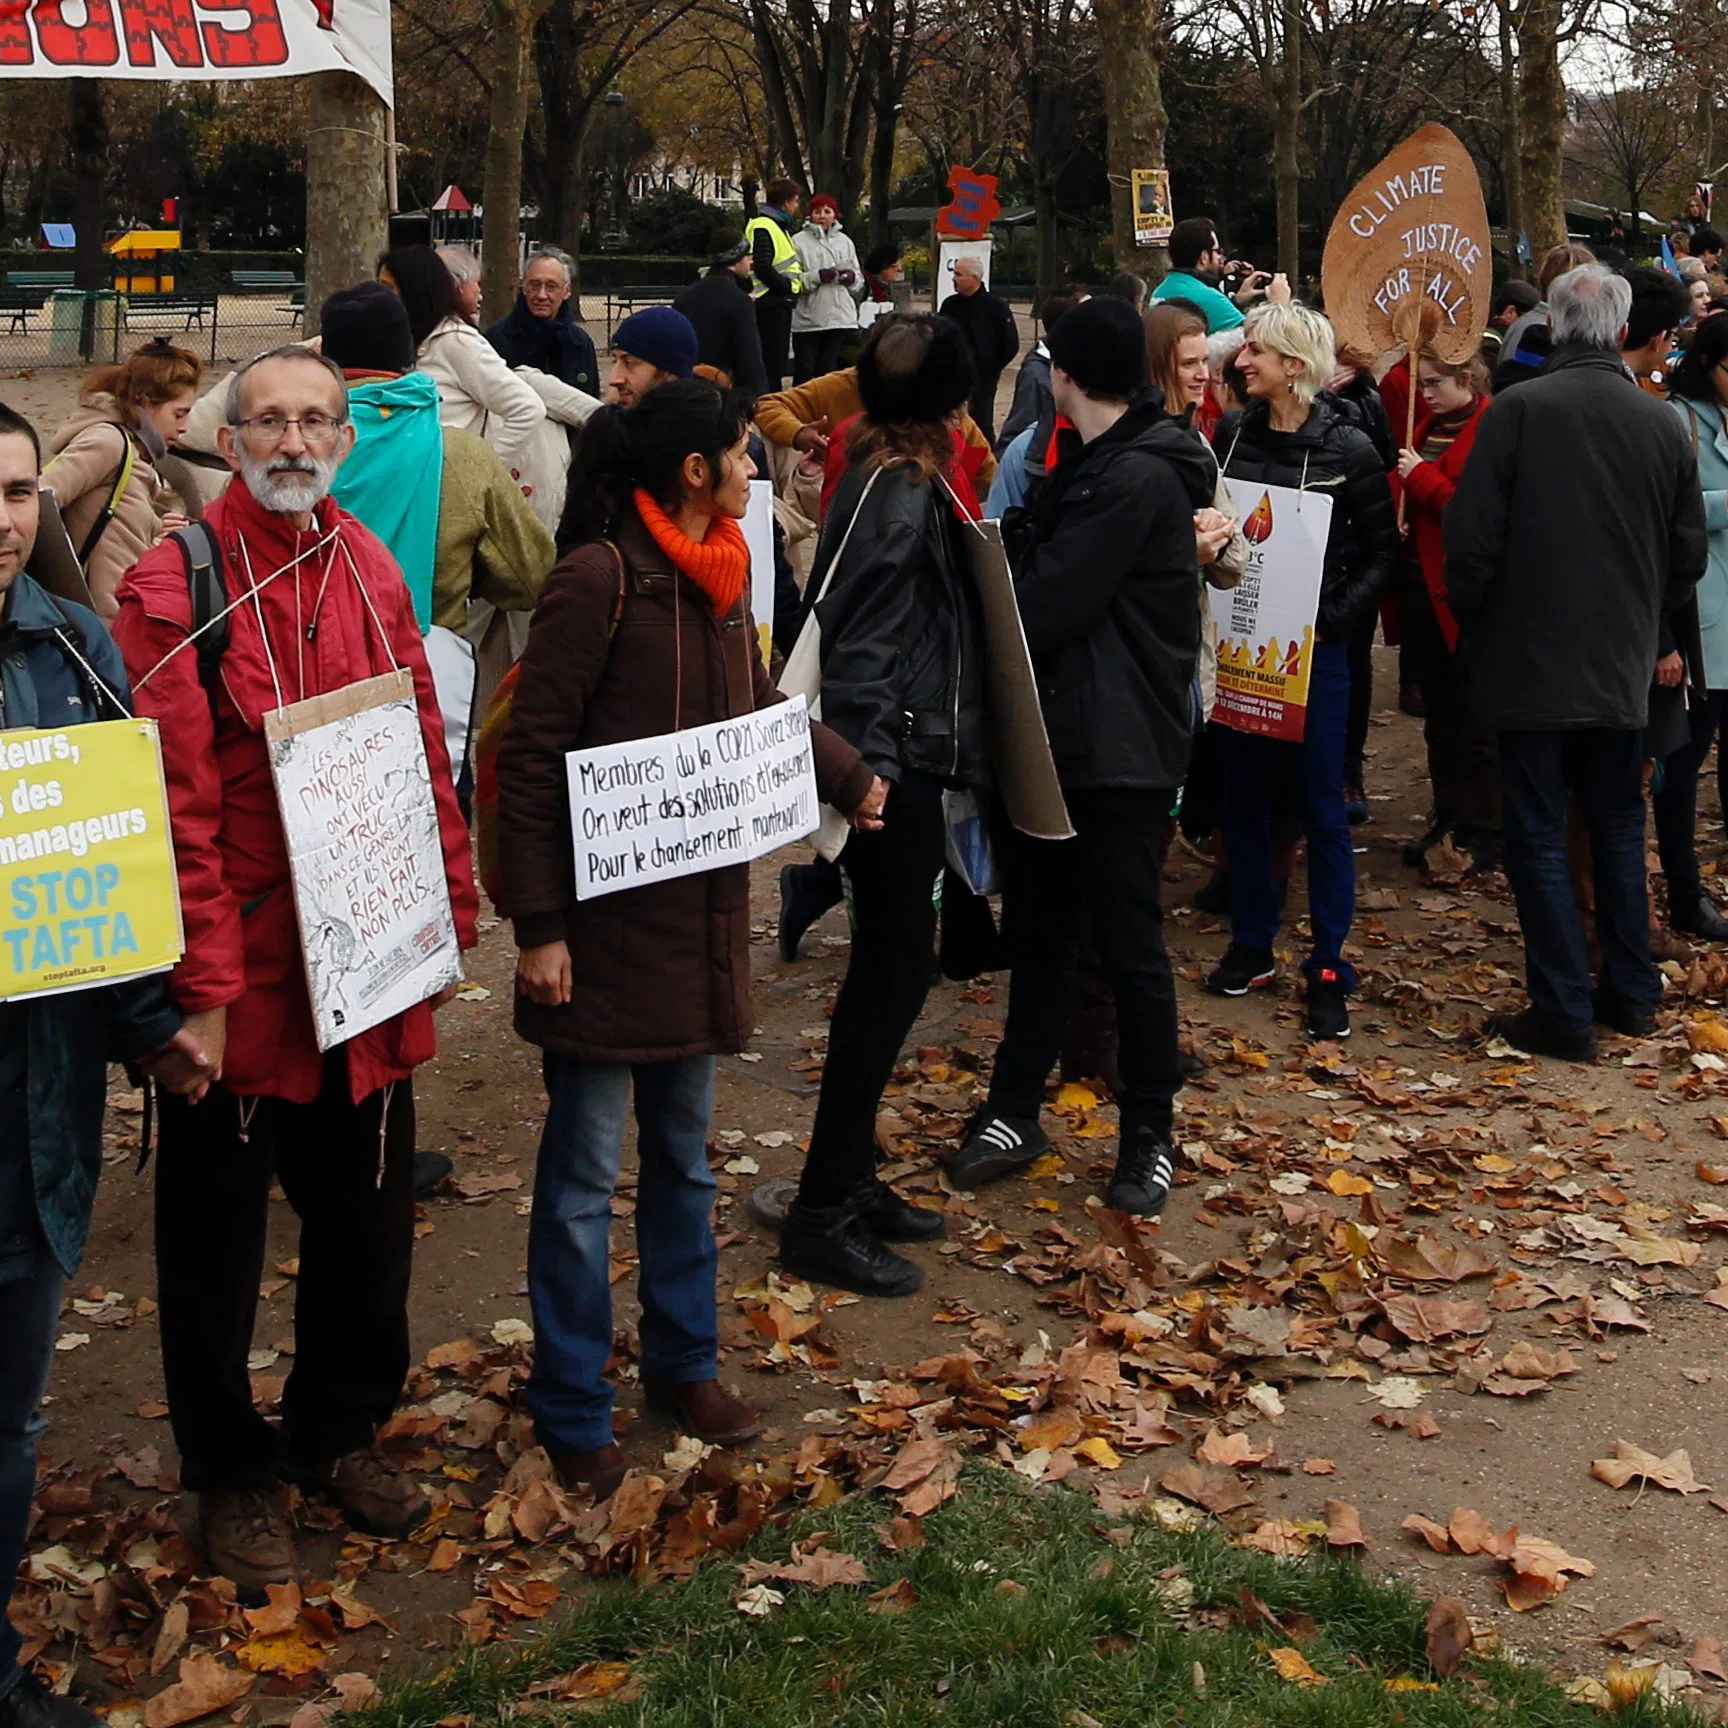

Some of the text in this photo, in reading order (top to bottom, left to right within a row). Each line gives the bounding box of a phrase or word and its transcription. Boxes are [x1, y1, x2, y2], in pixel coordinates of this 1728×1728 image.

[1349, 164, 1446, 238] CLIMATE
[1400, 222, 1482, 275] JUSTICE
[1373, 267, 1466, 326] FOR ALL
[298, 726, 395, 817] DINOSAURES
[311, 750, 333, 775] LES
[578, 754, 665, 797] Membres
[10, 777, 64, 816] des
[325, 806, 351, 836] ONT
[581, 806, 610, 842] On
[612, 793, 653, 832] veut
[658, 788, 686, 821] des
[686, 774, 756, 820] solutions
[319, 864, 348, 894] DANS
[363, 826, 399, 863] GENRE
[328, 804, 389, 862] UN TRUC
[587, 851, 630, 884] Pour
[631, 839, 648, 874] le
[10, 863, 120, 921] STOP
[344, 874, 360, 901] ET
[350, 851, 417, 926] RIEN FAIT
[2, 911, 140, 974] TAFTA
[359, 909, 391, 948] NON
